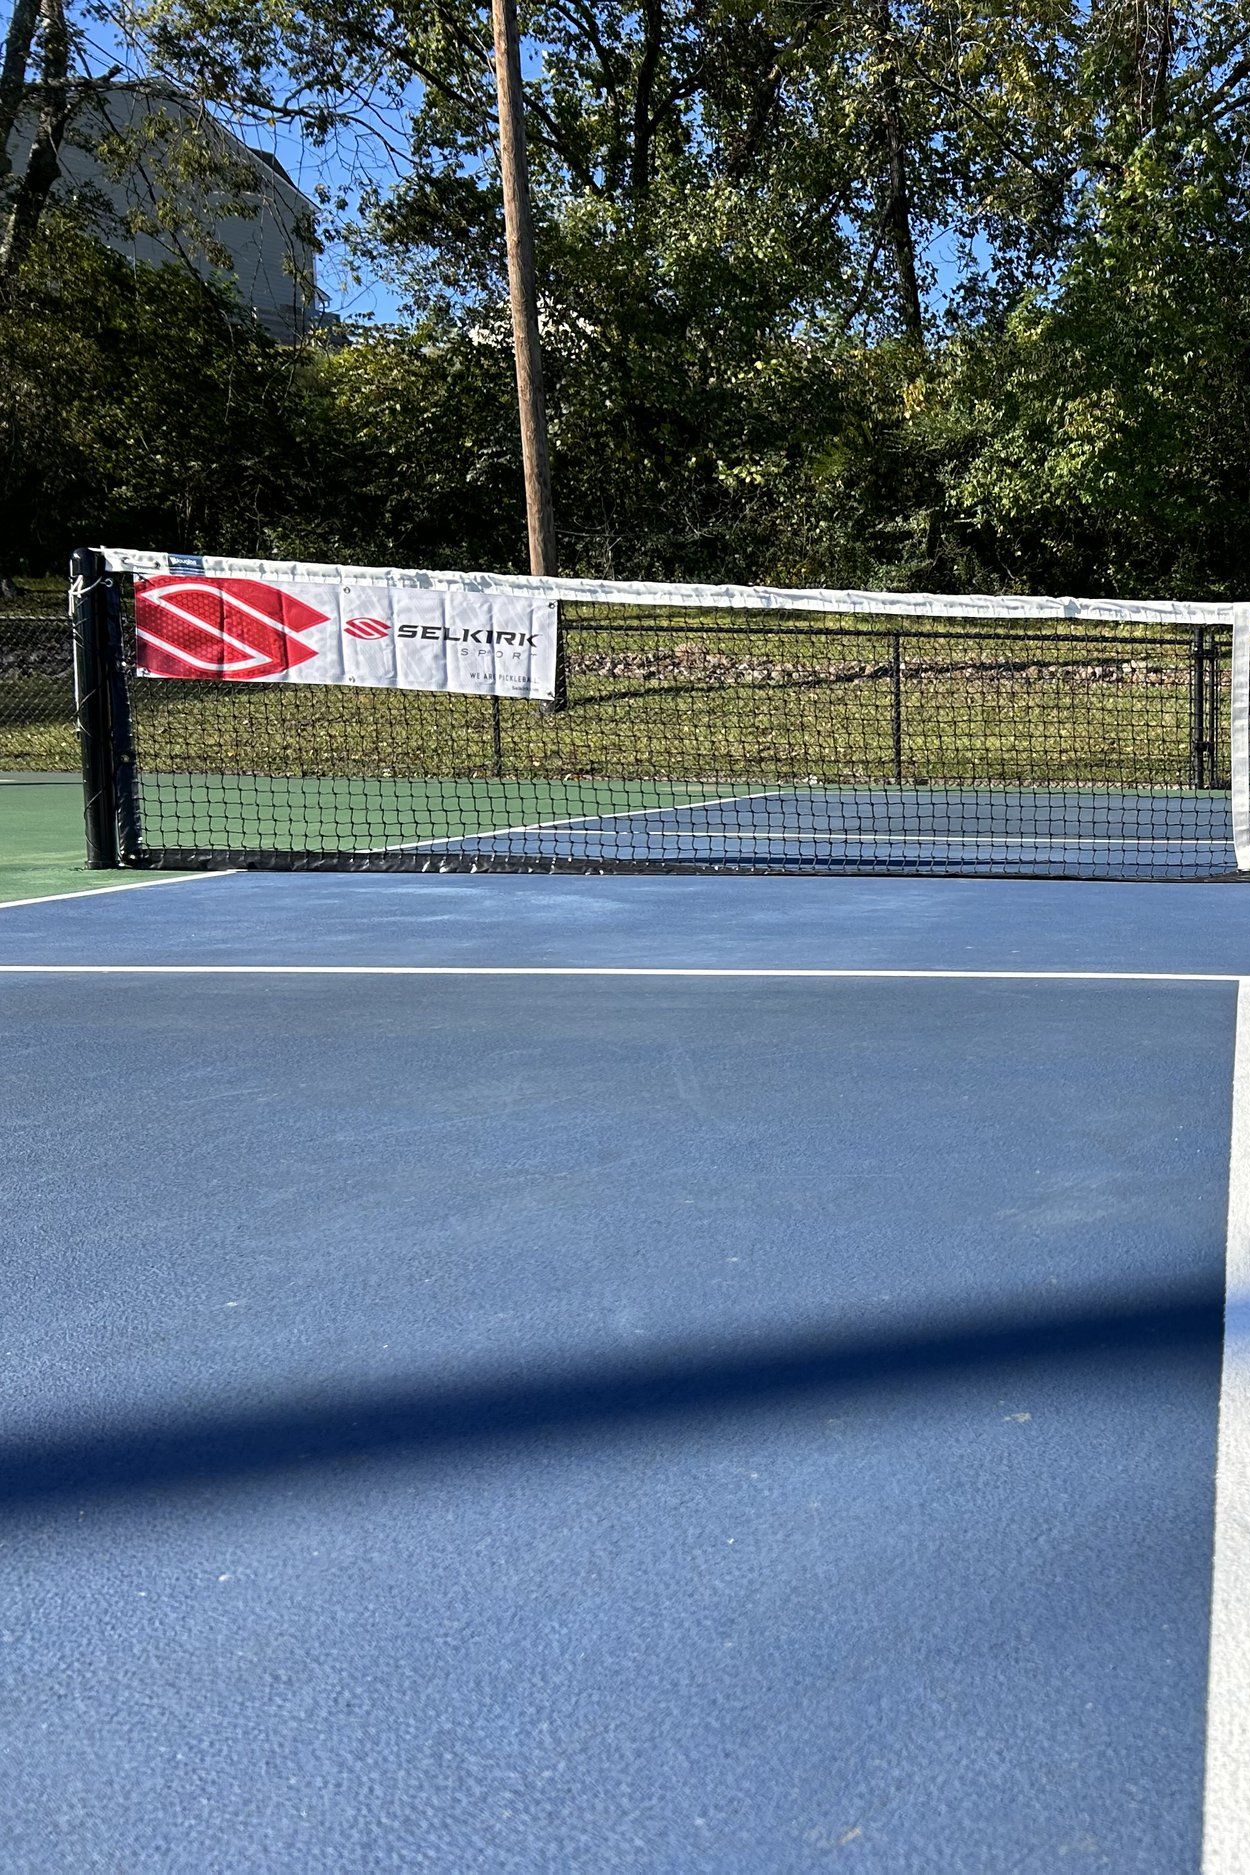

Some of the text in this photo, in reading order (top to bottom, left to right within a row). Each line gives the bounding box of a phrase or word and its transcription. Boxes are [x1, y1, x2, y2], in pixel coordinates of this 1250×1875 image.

[397, 624, 543, 648] SELKIRK
[470, 672, 481, 680] WE
[499, 674, 539, 684] PICKLEBAL
